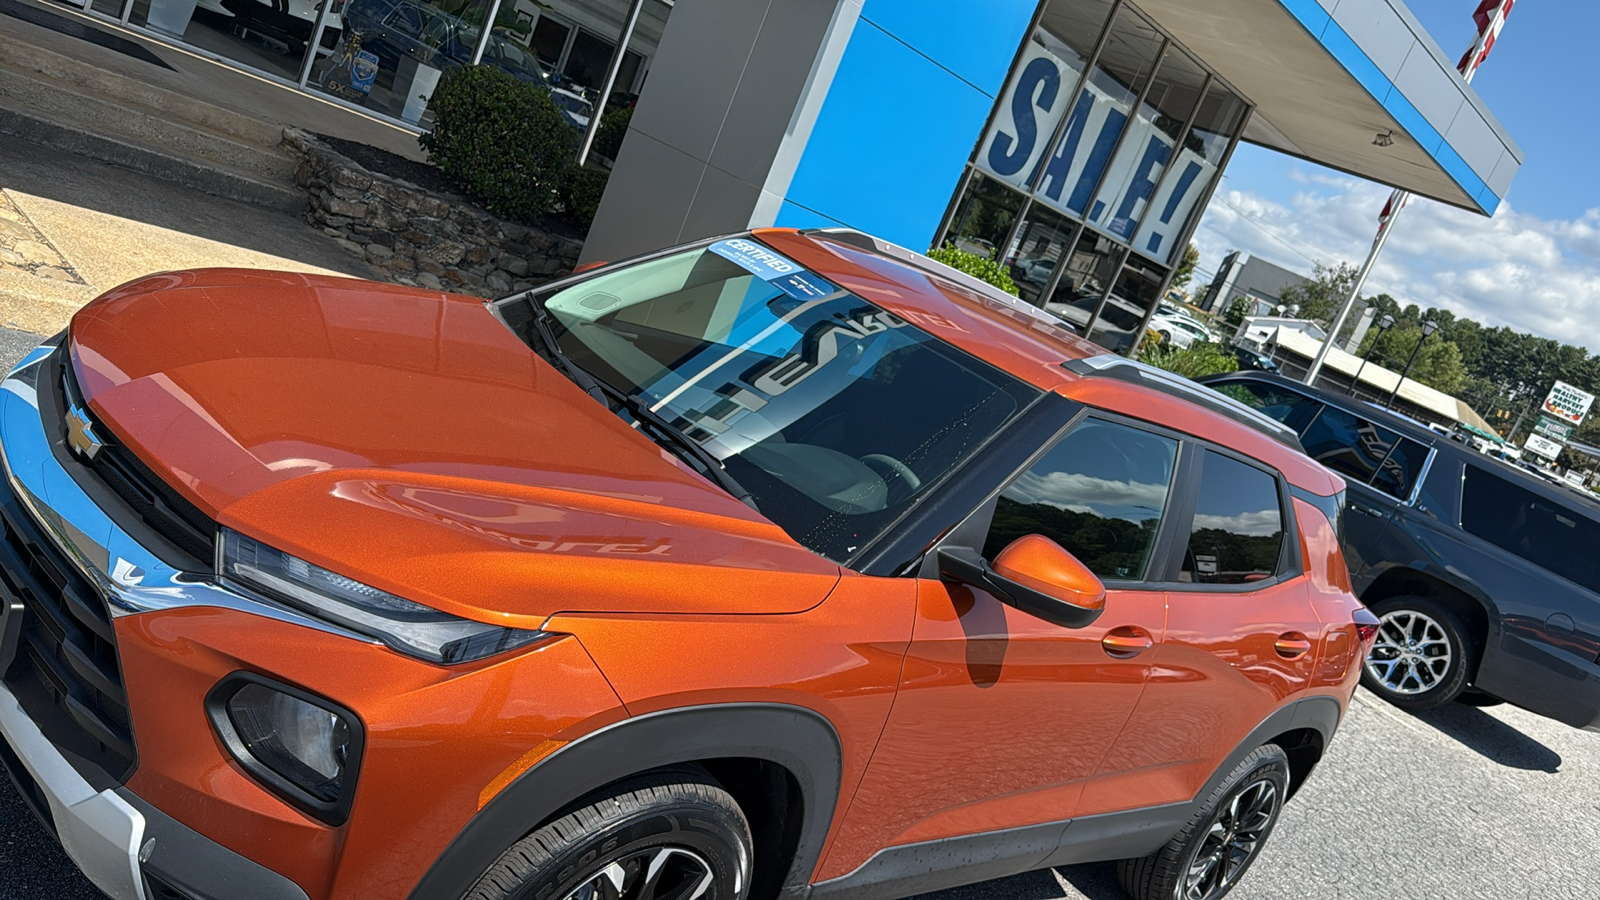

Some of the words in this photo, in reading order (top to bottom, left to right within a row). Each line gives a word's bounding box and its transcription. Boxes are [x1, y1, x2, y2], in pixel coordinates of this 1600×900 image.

[988, 57, 1203, 254] SALE!
[725, 239, 793, 273] CERTIFIED
[1553, 387, 1583, 403] HEALTHY
[1553, 394, 1584, 410] HARVEST
[1552, 400, 1584, 417] PRODUCE
